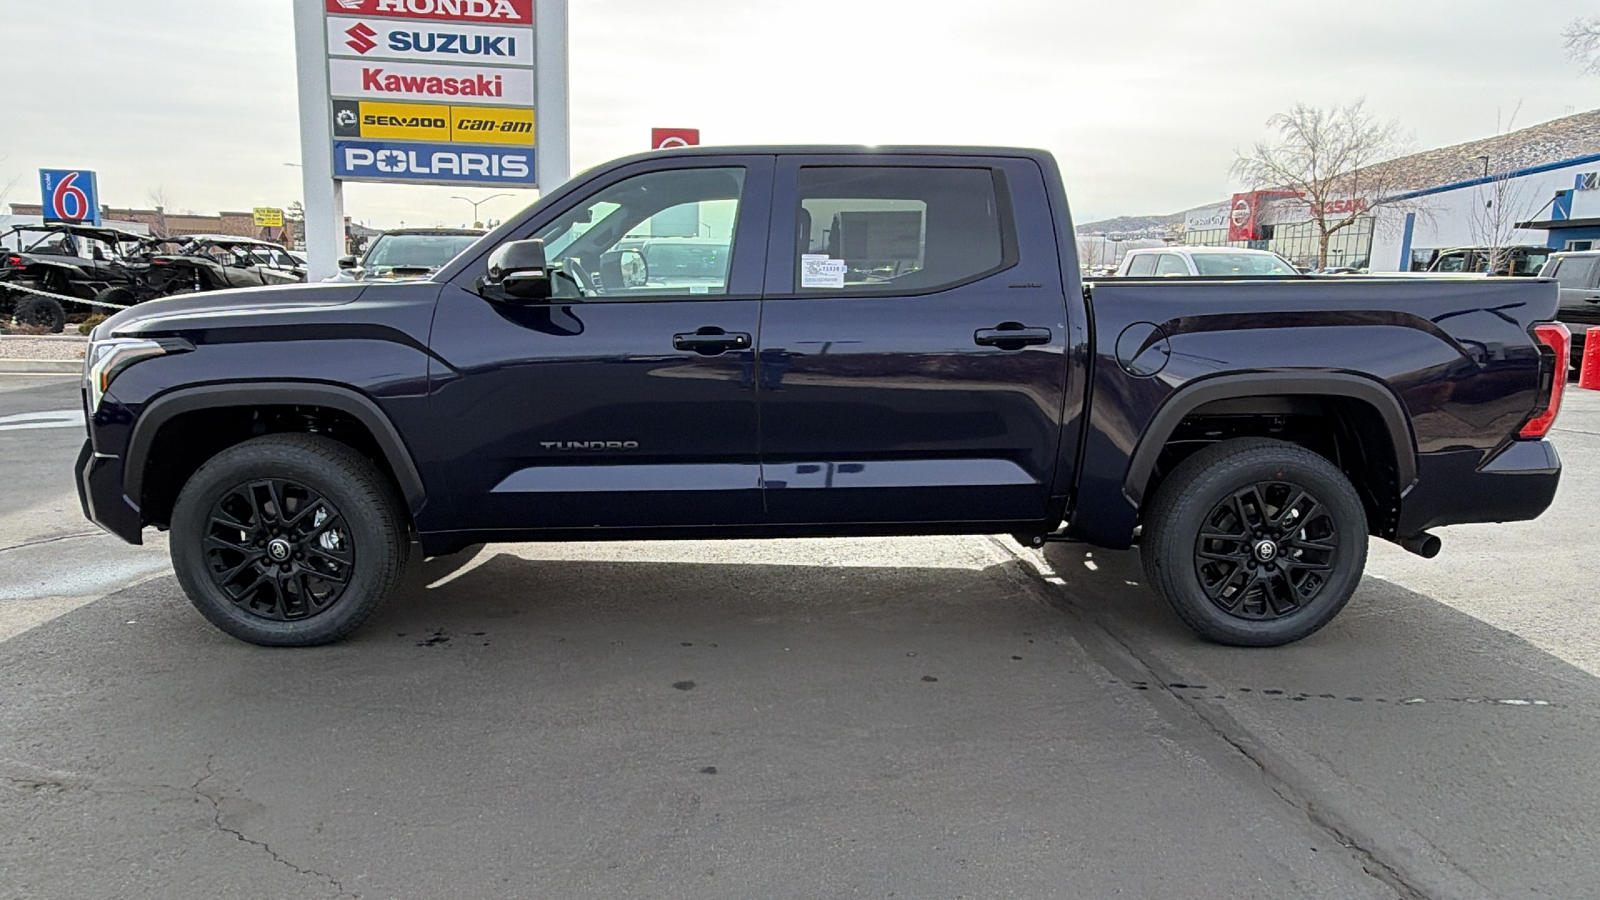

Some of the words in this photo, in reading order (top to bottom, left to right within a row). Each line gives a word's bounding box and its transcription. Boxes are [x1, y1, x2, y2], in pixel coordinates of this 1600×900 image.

[376, 0, 521, 19] HONDA
[387, 31, 516, 57] SUZUKI
[362, 67, 503, 97] Kawasaki
[344, 147, 529, 177] POLARIS
[53, 171, 89, 220] 6
[1310, 198, 1368, 216] NSSAN
[539, 440, 639, 452] TUNDRA
